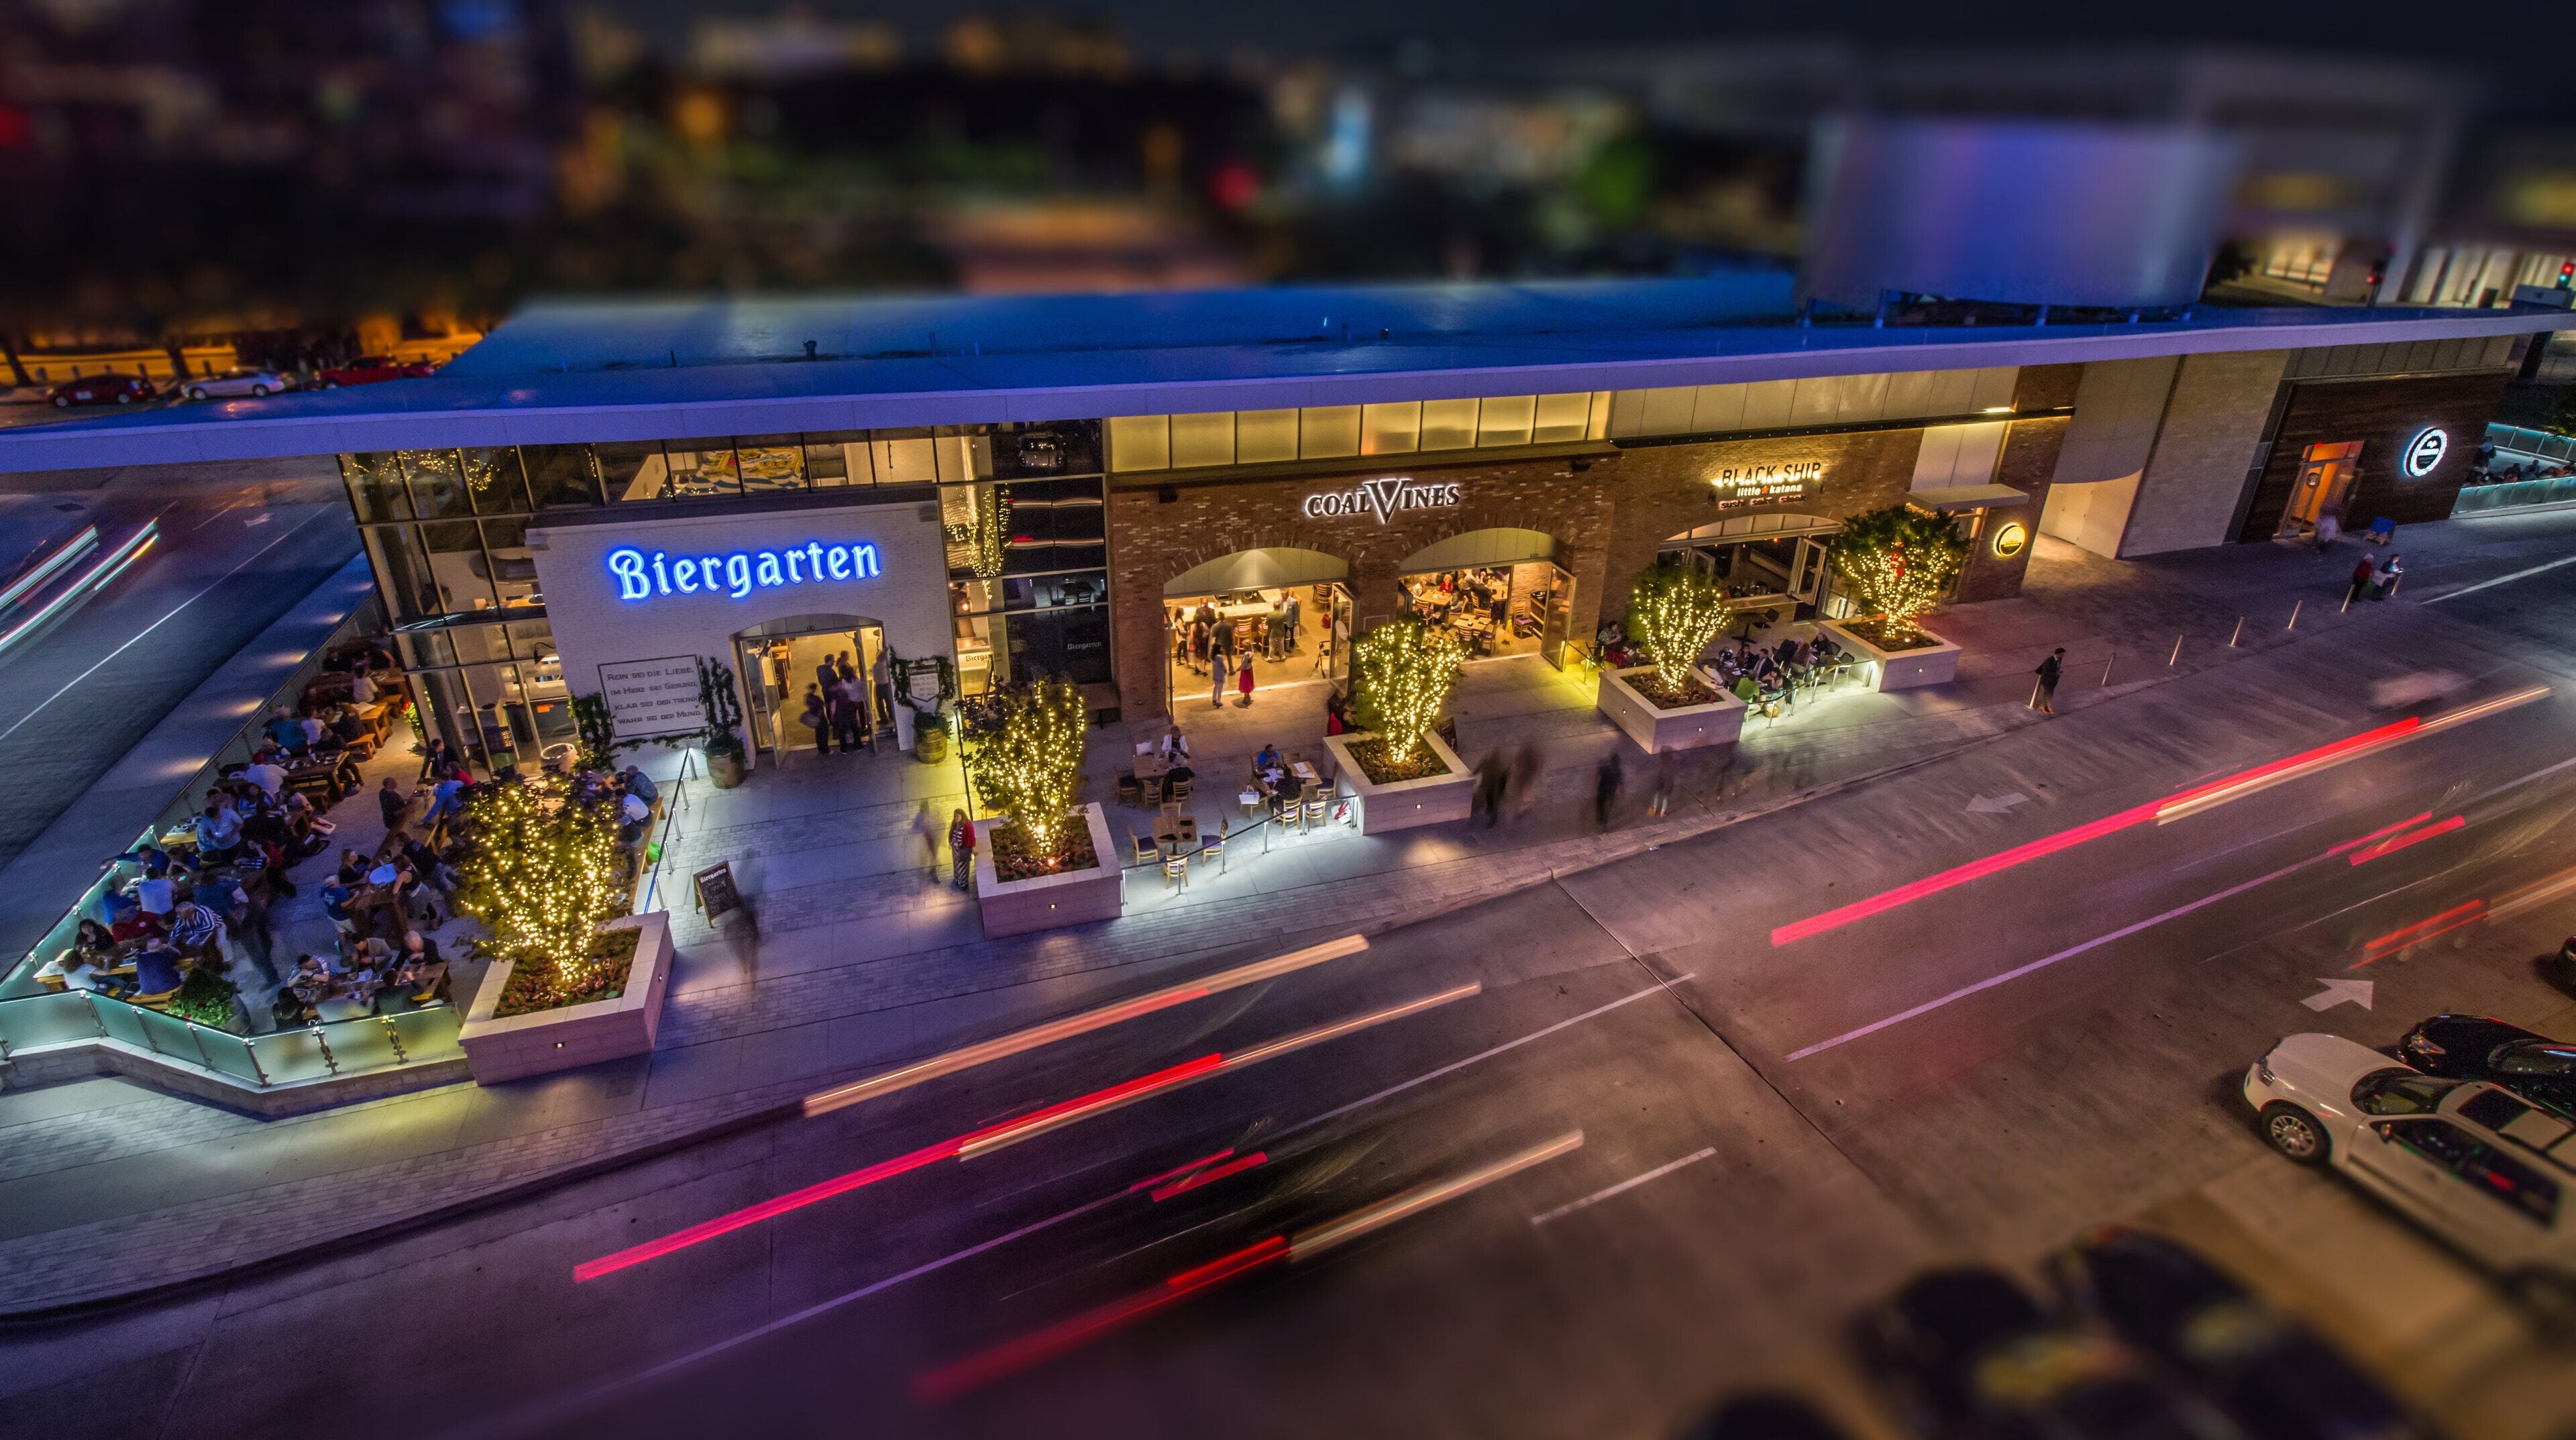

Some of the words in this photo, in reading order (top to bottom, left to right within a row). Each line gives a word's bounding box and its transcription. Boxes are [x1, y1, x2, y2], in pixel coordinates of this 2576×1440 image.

[1722, 466, 1777, 484] BLACK
[1784, 462, 1821, 480] SHIP
[1736, 485, 1762, 497] little
[1769, 484, 1803, 494] katana
[608, 541, 881, 600] Biergarten
